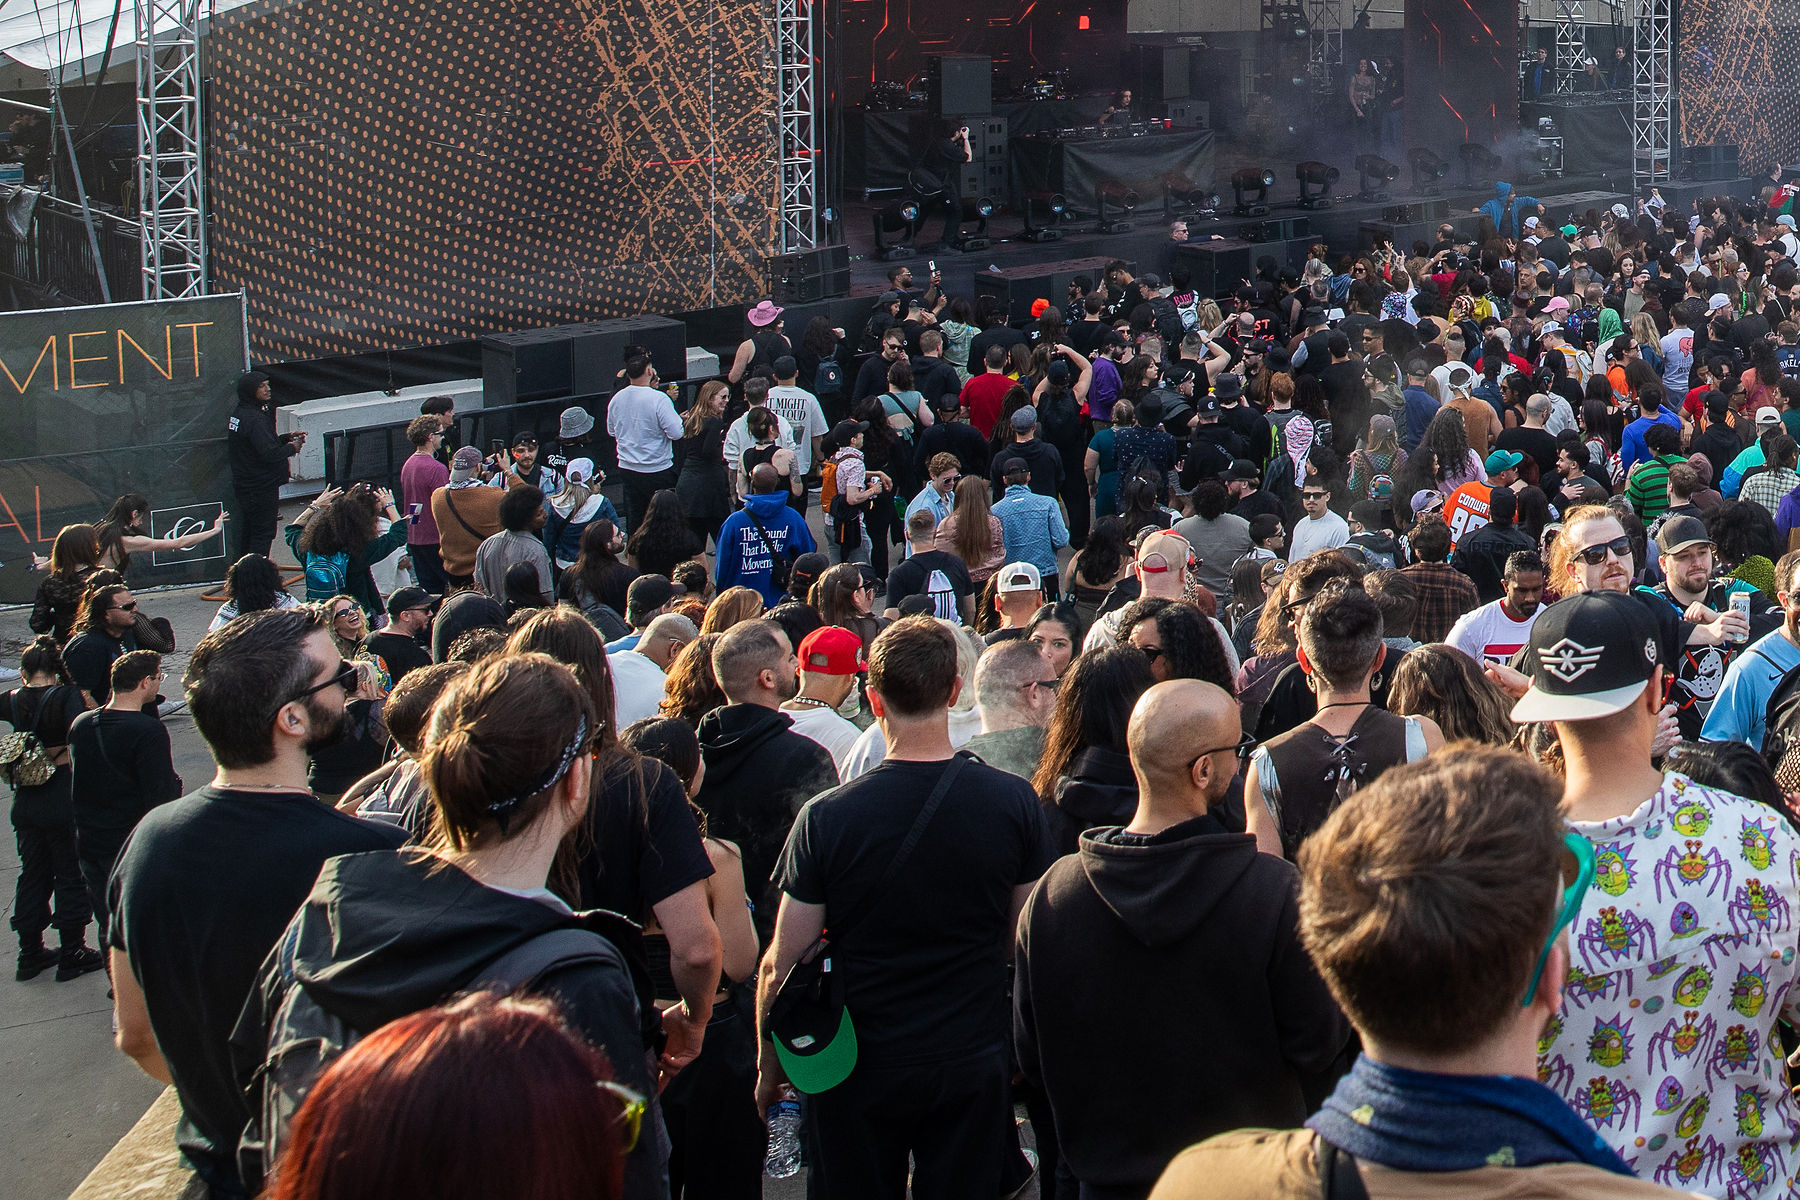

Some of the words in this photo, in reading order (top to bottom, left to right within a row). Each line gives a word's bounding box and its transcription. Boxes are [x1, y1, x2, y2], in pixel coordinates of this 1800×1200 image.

[776, 398, 806, 409] MIGHT
[740, 526, 758, 542] The
[759, 525, 789, 540] ound
[740, 542, 759, 557] That
